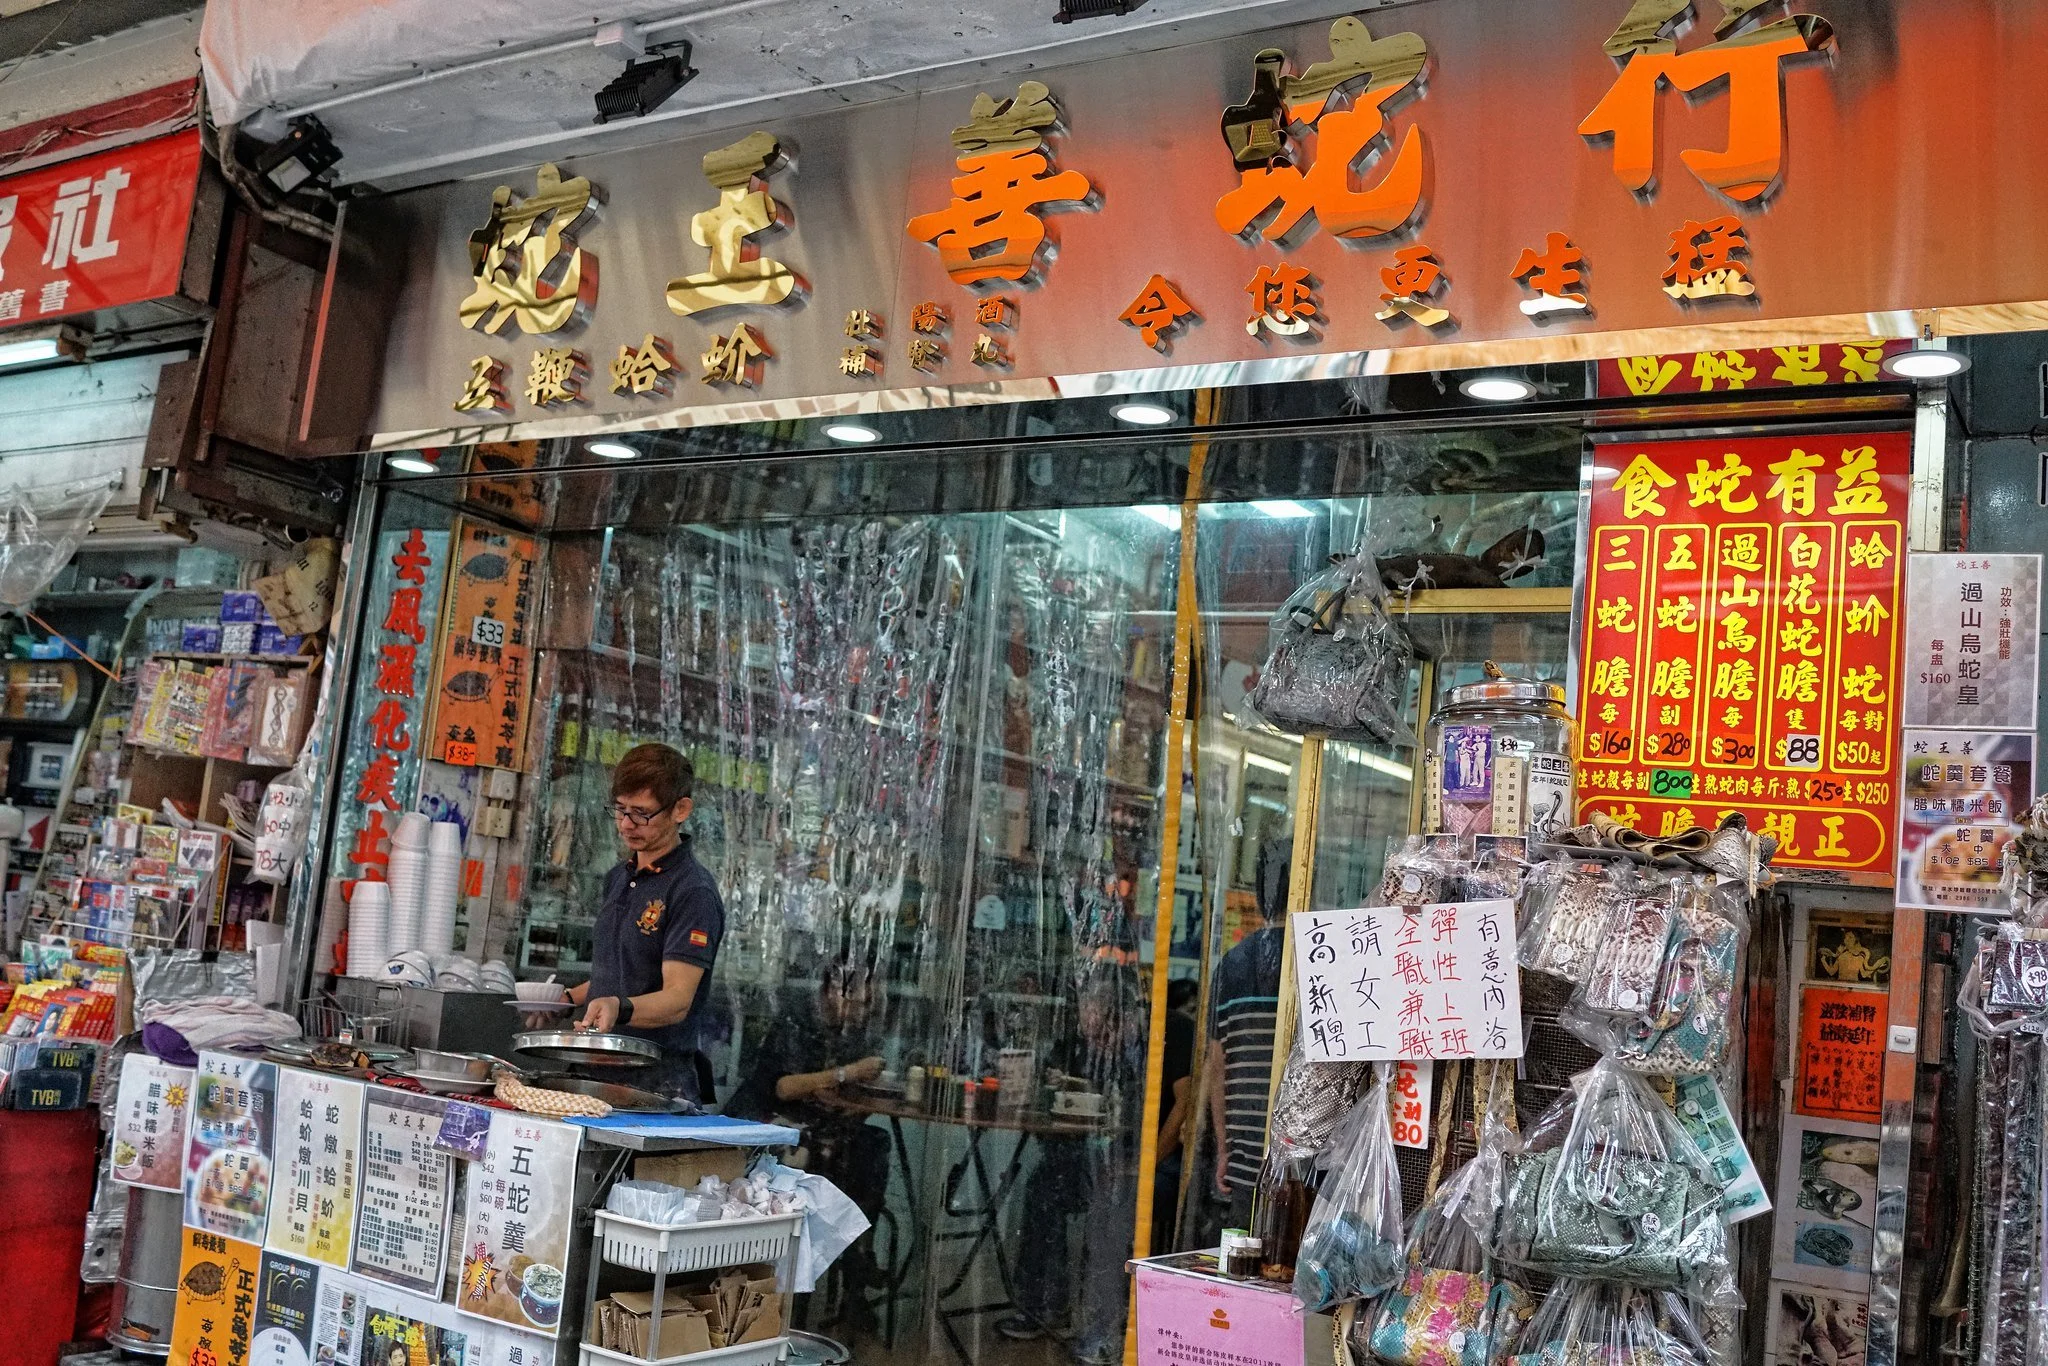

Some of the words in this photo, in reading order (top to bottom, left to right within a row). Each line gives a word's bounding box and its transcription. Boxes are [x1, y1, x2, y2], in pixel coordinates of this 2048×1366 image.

[1117, 215, 1756, 348] 令您更生猛
[1611, 445, 1888, 519] 食蛇有益
[1956, 559, 1992, 571] 蛇王善
[1591, 534, 1637, 698] 三蛇膽
[1650, 533, 1698, 699] 五蛇膽
[1775, 531, 1823, 703] 白花蛇膽
[1840, 530, 1893, 705] 蛤蚧蛇
[1957, 582, 1984, 706] 過山烏蛇皇
[1920, 672, 1951, 685] $160
[1598, 702, 1620, 724] 每
[1660, 704, 1681, 727] 副
[1720, 706, 1744, 729] 每
[1784, 708, 1808, 731] 隻
[1838, 709, 1885, 733] 每對
[1589, 730, 1632, 756] $160
[1647, 731, 1692, 757] $280
[1711, 736, 1755, 765] $300
[1775, 737, 1819, 764] $88
[1913, 740, 1974, 756] 蛇王善
[1921, 763, 2012, 784] 蛇羹套餐
[1653, 769, 1692, 793] 800
[1856, 781, 1890, 806] $250
[1913, 797, 2002, 814] 腊味糯米飯
[1941, 843, 1952, 854] 大
[1973, 844, 1984, 855] 中
[1956, 828, 1995, 844] 蛇羹
[1931, 855, 1960, 866] $102
[1967, 857, 1989, 867] $85
[1304, 917, 1347, 1057] 高薪聘
[1345, 914, 1387, 1050] 請女工
[1391, 914, 1438, 1060] 全職兼職
[1431, 906, 1476, 1056] 彈性上班
[514, 1126, 543, 1143] 蛇王善
[295, 1098, 314, 1213] 蛤蚧燉川貝
[320, 1103, 340, 1219] 蛇燉蛤蚧
[482, 1162, 495, 1174] $42
[479, 1193, 493, 1205] $60
[494, 1178, 506, 1211] 每碗
[501, 1145, 534, 1254] 五蛇羹
[476, 1224, 489, 1236] $78
[478, 1210, 490, 1223] (大)
[227, 1268, 256, 1366] 正式龜苓
